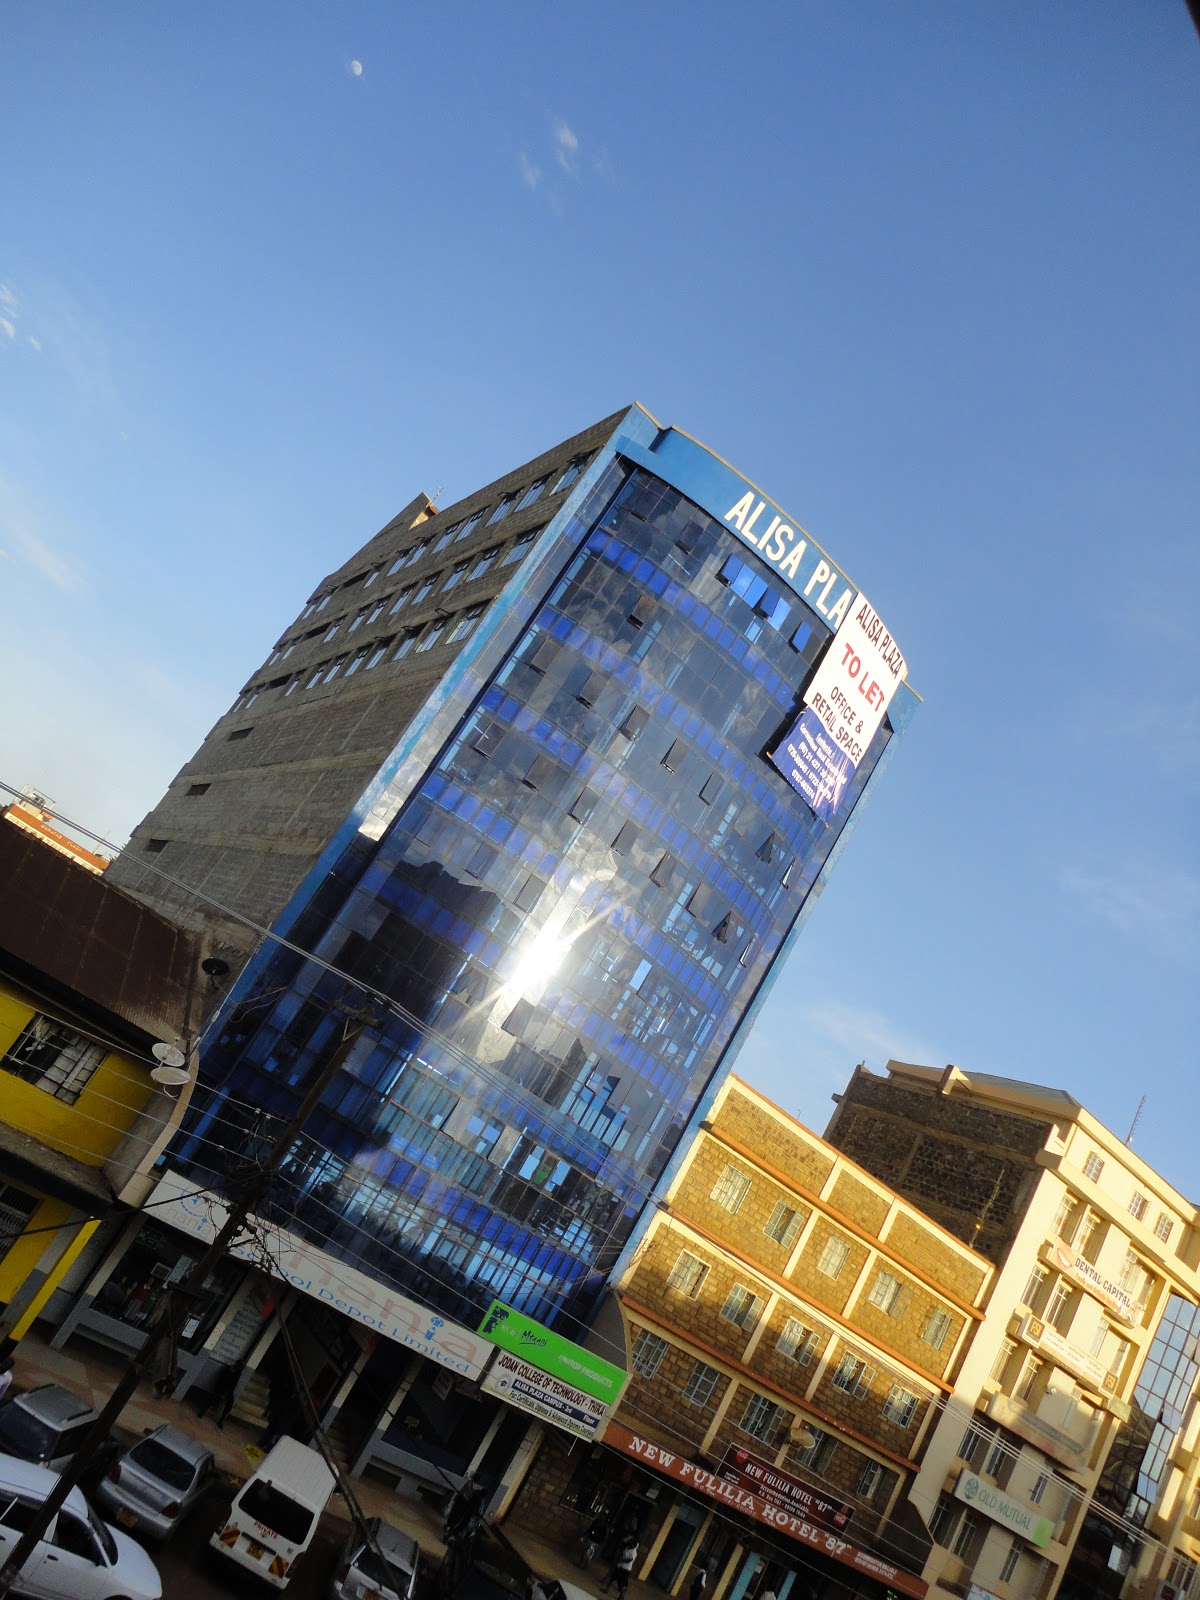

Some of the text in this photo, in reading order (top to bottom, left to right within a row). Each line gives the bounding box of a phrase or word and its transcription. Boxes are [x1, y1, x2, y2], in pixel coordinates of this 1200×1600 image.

[724, 491, 807, 579] ALISA
[856, 603, 904, 680] ALISA PLAZA
[841, 642, 885, 712] TO LET
[811, 692, 863, 762] RETAIL SPACE
[830, 686, 864, 735] OFFICE &
[1074, 1257, 1102, 1285] DENTAL
[1102, 1280, 1131, 1308] CAPITAL
[318, 1287, 385, 1330] Depot
[391, 1327, 470, 1374] Limited
[498, 1355, 520, 1374] JODAN
[517, 1364, 544, 1386] COLLEGE
[541, 1377, 553, 1389] OF
[550, 1381, 588, 1407] TECHNOLOGY
[587, 1398, 606, 1417] THIKA
[514, 1381, 529, 1393] ALISA
[528, 1388, 545, 1401] PLAZA
[542, 1395, 563, 1410] CAMPUS
[583, 1413, 596, 1425] Floor
[580, 1366, 614, 1388] PRODUCTS
[629, 1436, 852, 1555] NEW FULILIA HOTEL "87"
[745, 1463, 764, 1479] NEW
[762, 1472, 791, 1493] FULILIA
[790, 1486, 813, 1506] HOTEL
[978, 1489, 1032, 1531] OLD MUTUAL
[254, 1520, 278, 1539] PRIVATE
